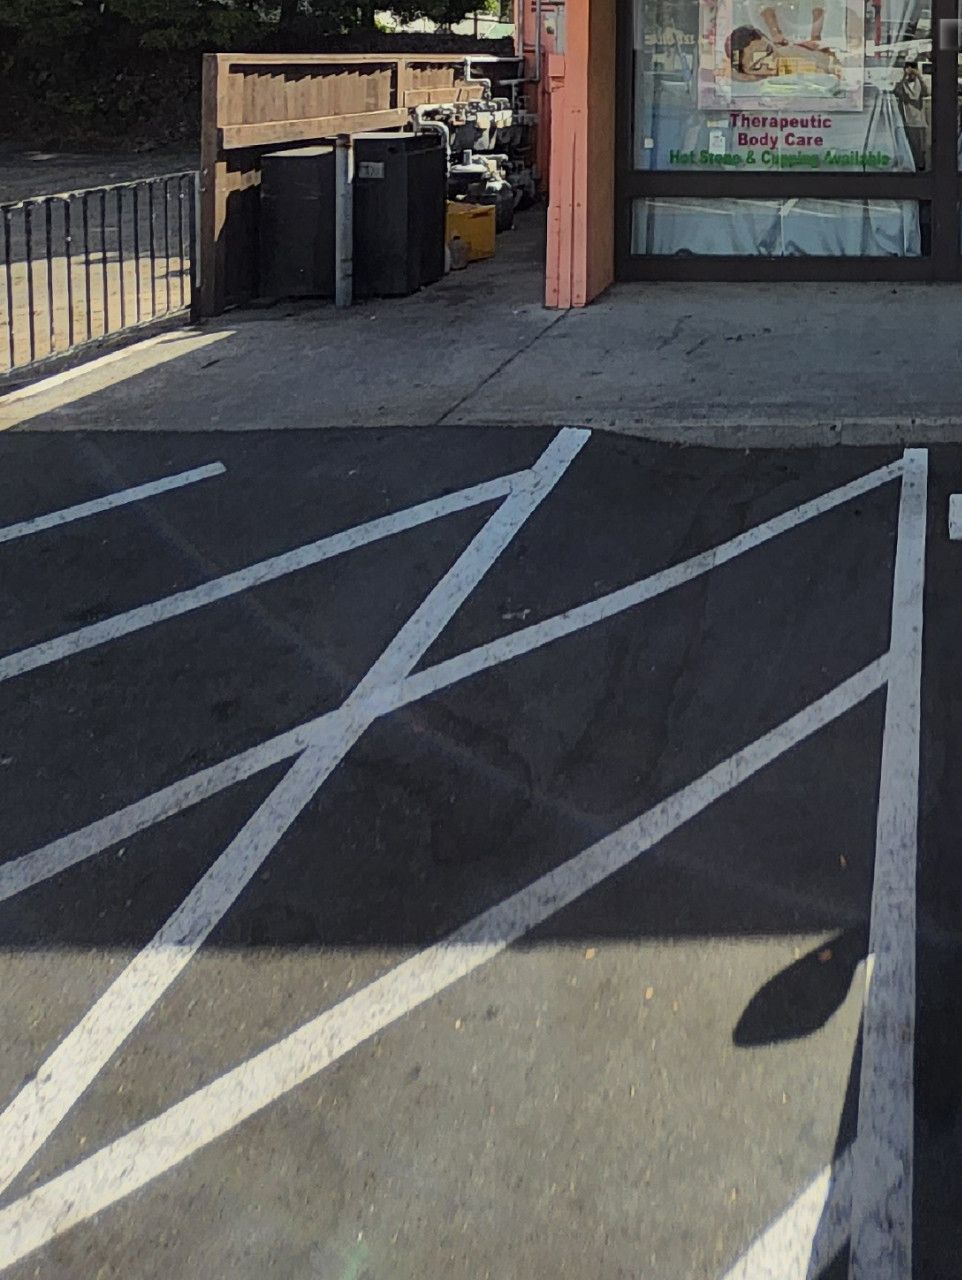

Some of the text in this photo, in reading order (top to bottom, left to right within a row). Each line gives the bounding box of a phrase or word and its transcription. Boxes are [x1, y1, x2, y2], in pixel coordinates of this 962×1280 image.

[729, 113, 832, 131] Therapeutic
[738, 132, 824, 150] Body Care
[745, 151, 756, 164] &
